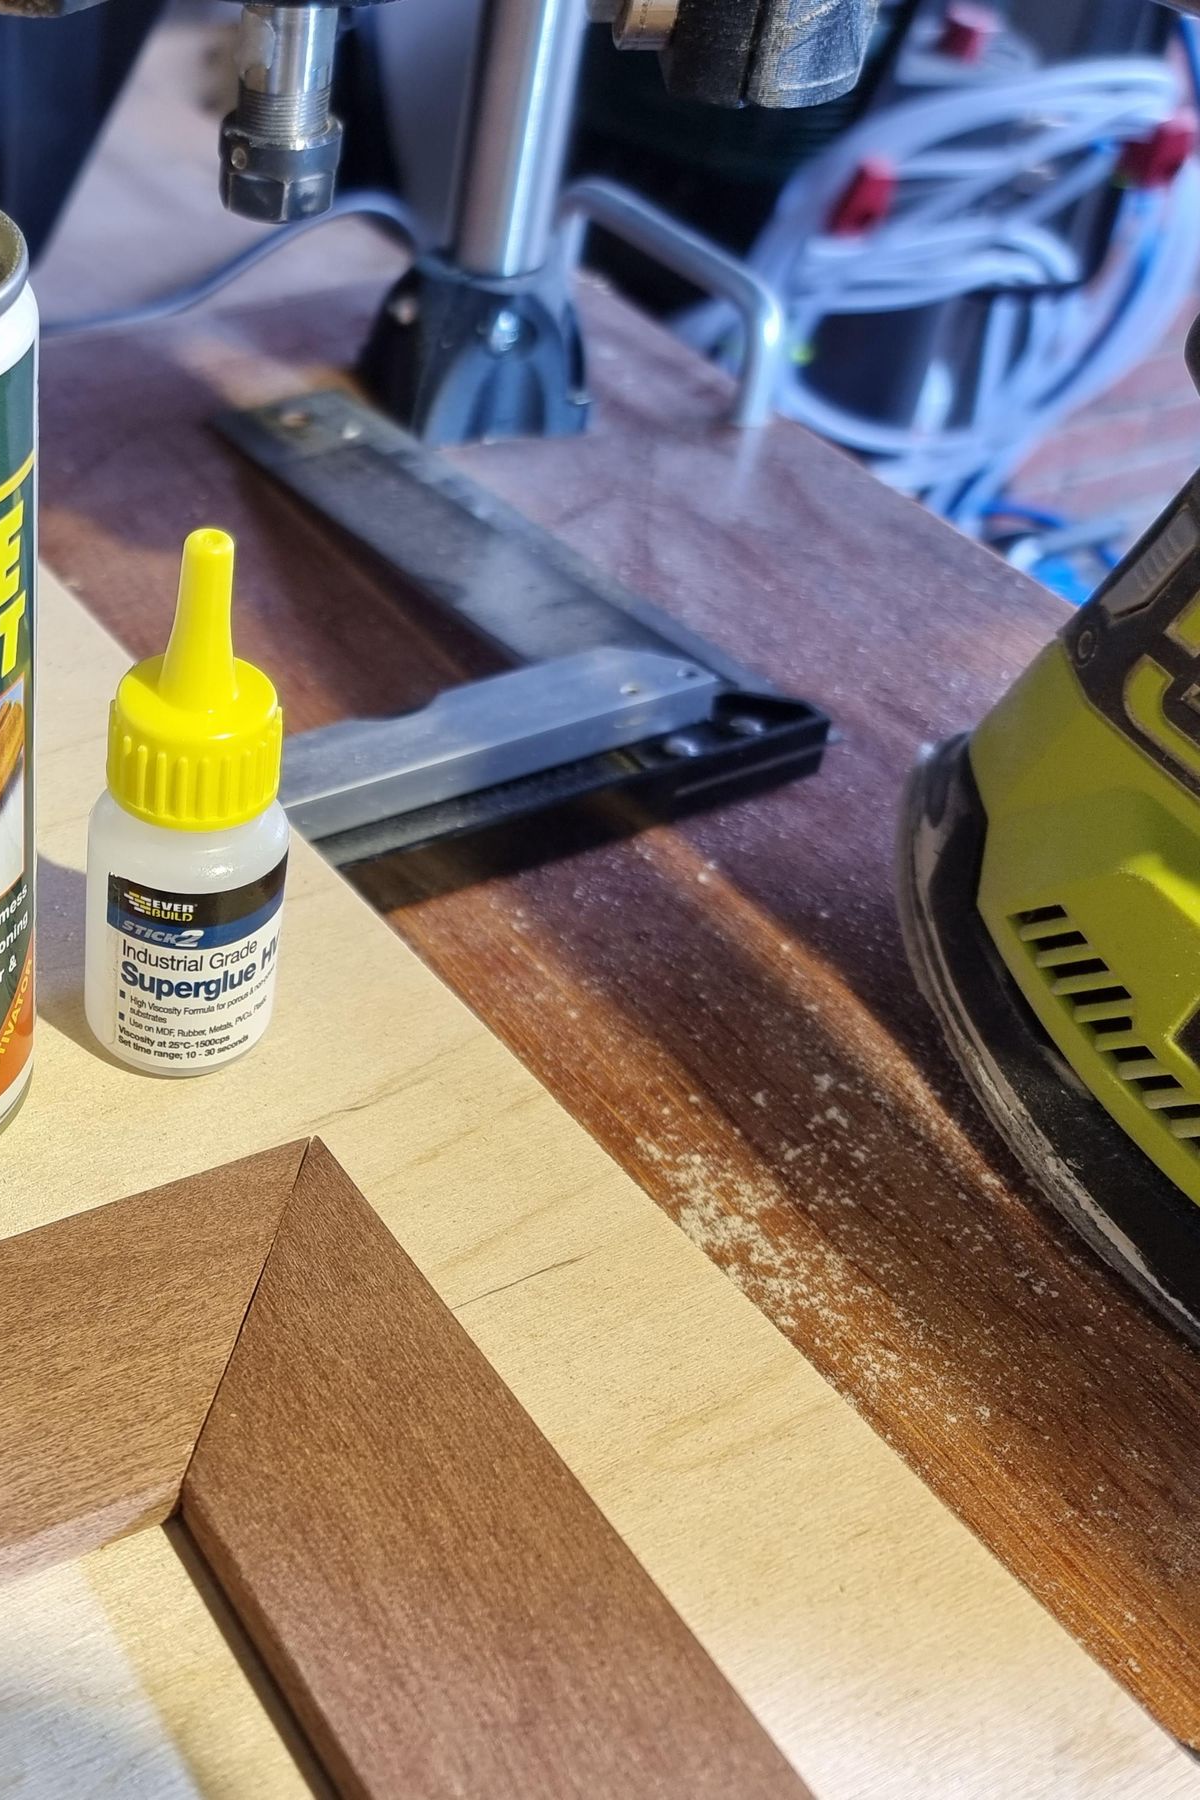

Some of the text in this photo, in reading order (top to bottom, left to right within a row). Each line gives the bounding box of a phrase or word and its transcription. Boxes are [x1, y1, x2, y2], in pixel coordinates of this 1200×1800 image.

[151, 908, 193, 922] BUILD
[152, 899, 194, 913] EVER
[8, 955, 18, 973] &
[122, 939, 258, 972] Industrial Grade
[120, 960, 257, 1002] Superglue
[130, 995, 147, 1009] High
[147, 1001, 182, 1016] Viscosity
[183, 1005, 215, 1016] Formula
[216, 1002, 226, 1011] for
[129, 1007, 168, 1024] substrates
[129, 1017, 143, 1030] Use
[144, 1025, 154, 1033] on
[118, 1024, 155, 1047] Viscosity
[118, 1035, 131, 1048] Set
[132, 1042, 152, 1055] time
[185, 1051, 197, 1059] 10
[204, 1047, 216, 1057] 30
[217, 1034, 249, 1054] seconds
